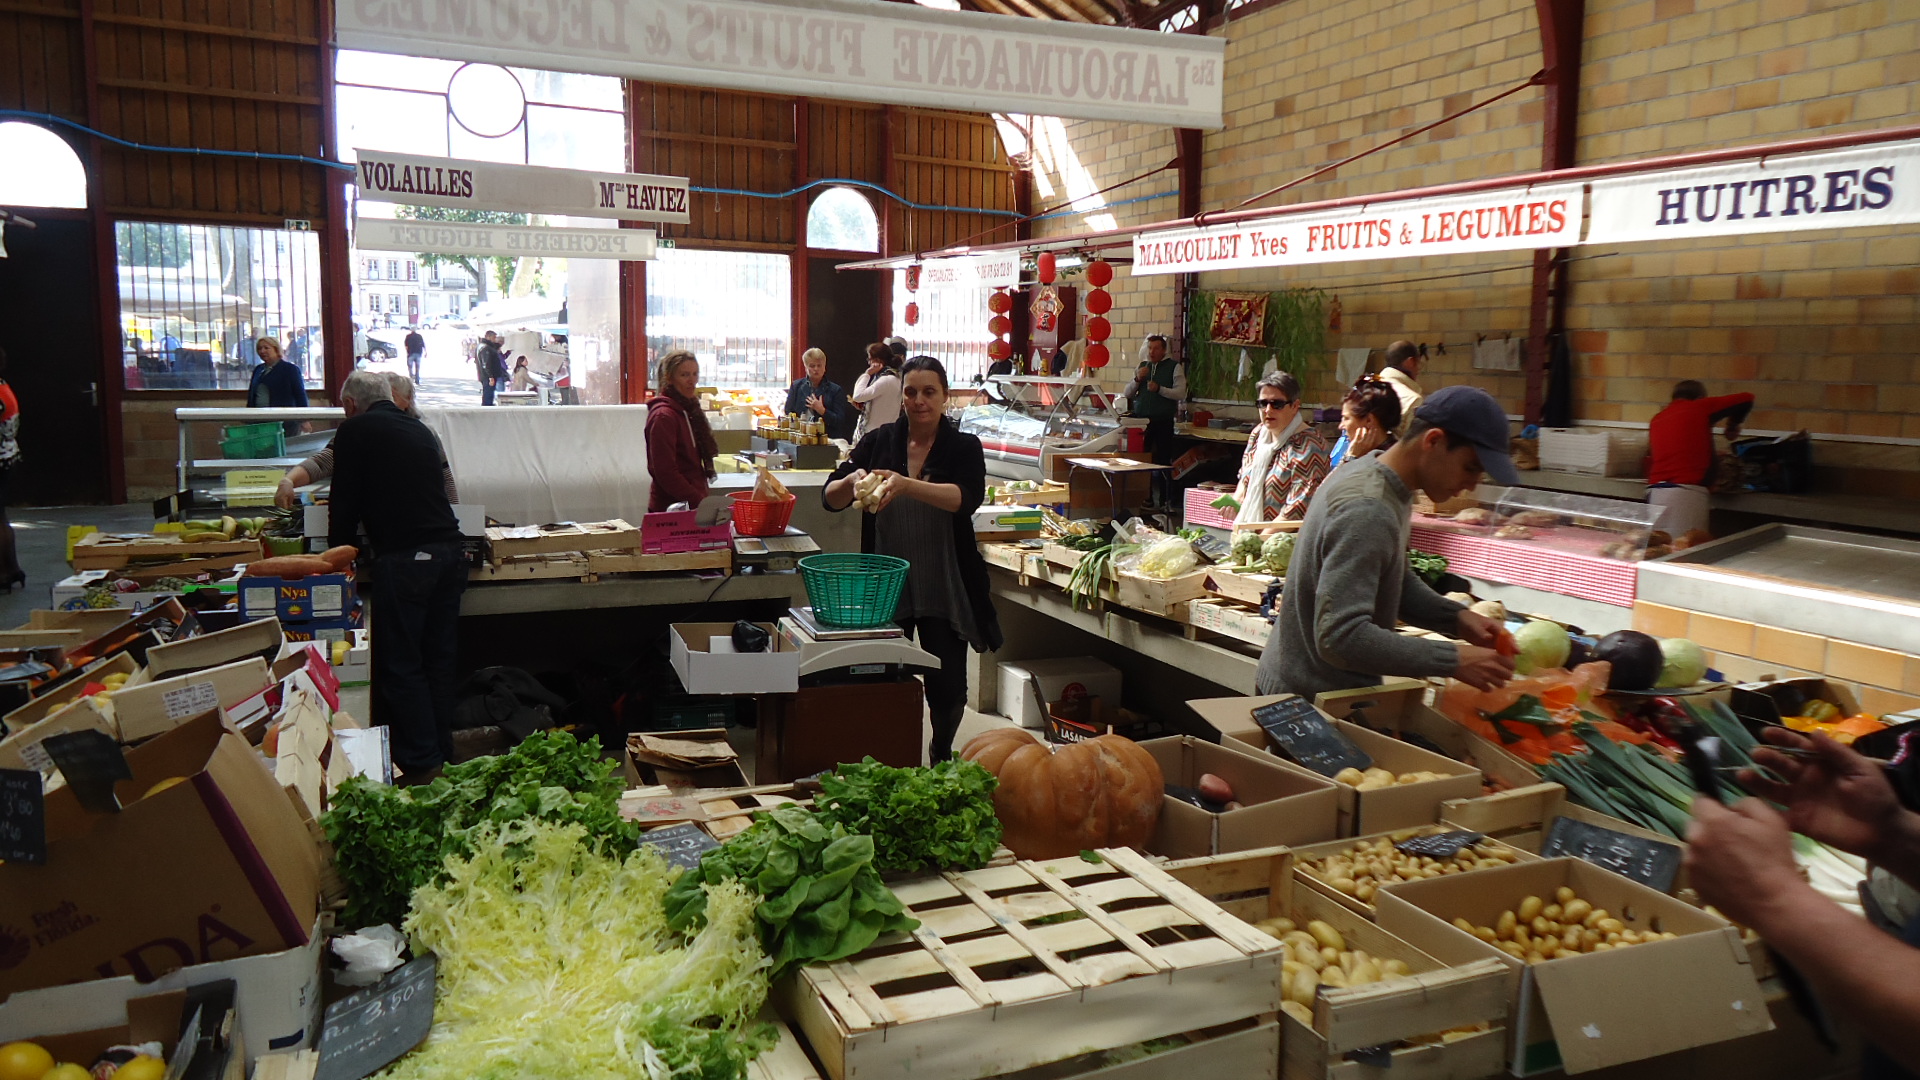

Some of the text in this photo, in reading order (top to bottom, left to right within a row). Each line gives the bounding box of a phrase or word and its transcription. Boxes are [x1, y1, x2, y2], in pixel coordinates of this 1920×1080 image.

[361, 160, 473, 198] VOLAILLES
[626, 184, 686, 212] HAVIEZ
[1656, 166, 1894, 225] HUITRES
[1139, 200, 1567, 266] MARCOULET Yves FRUITS & LEGUMES
[281, 586, 308, 600] Nya
[32, 899, 78, 928] Fresh
[96, 913, 256, 984] DA
